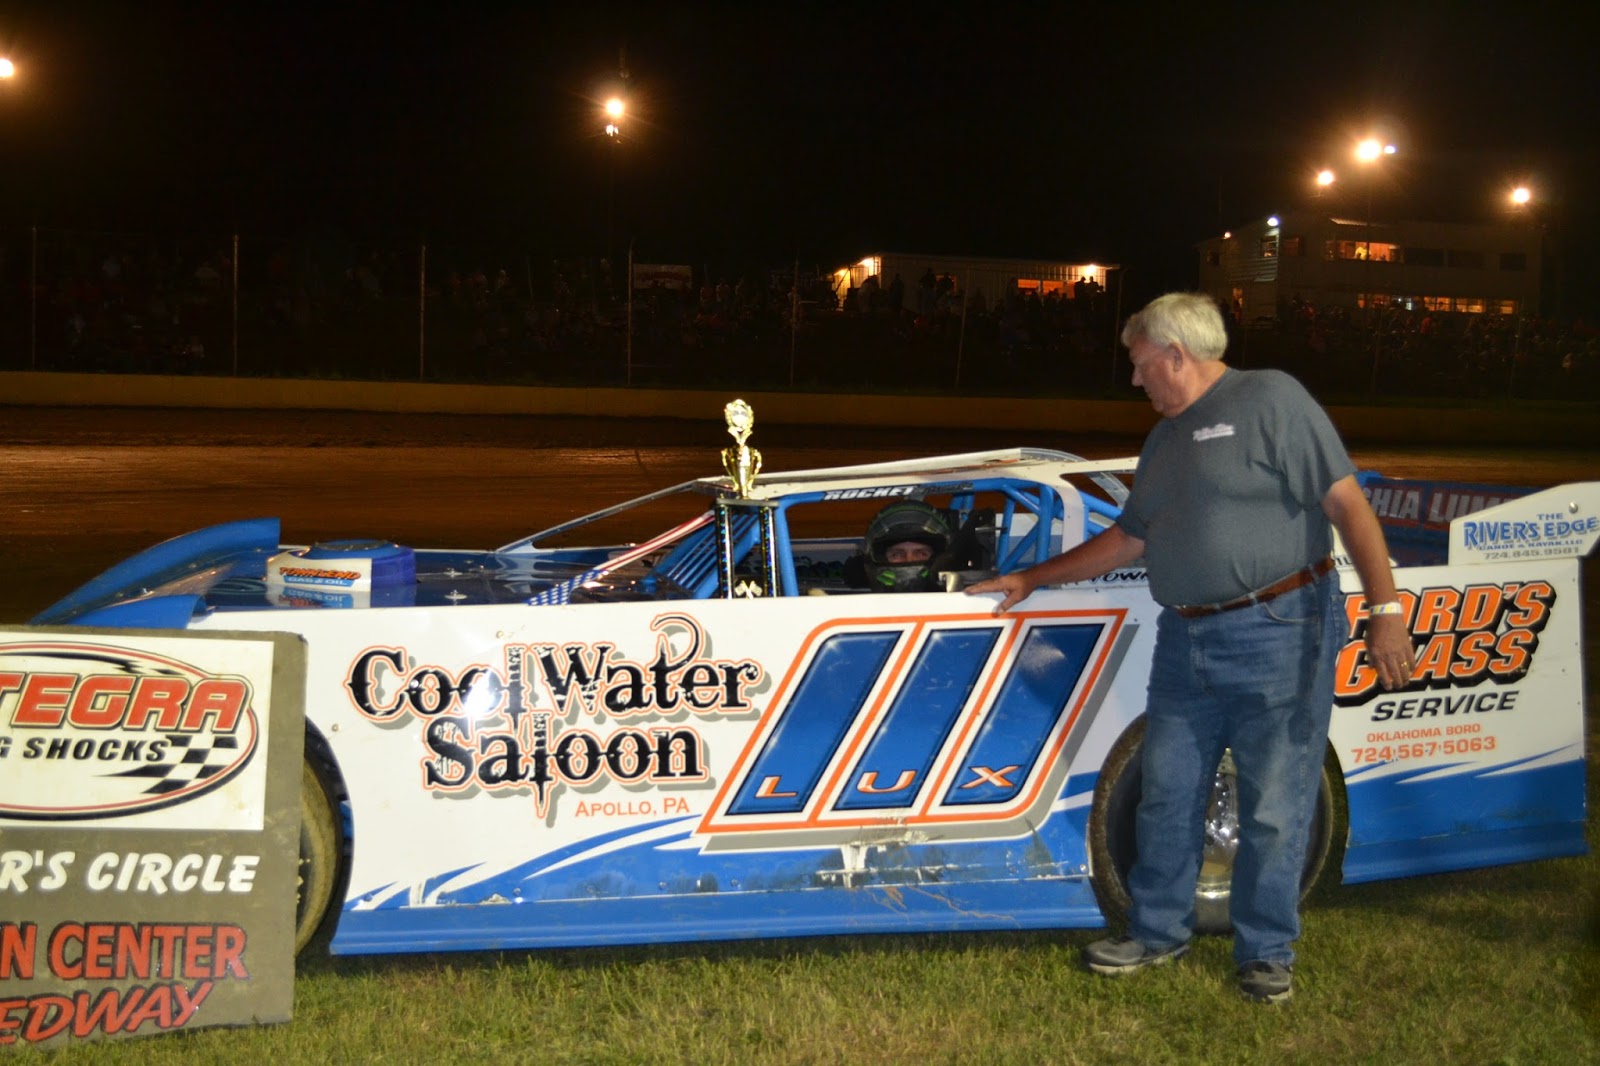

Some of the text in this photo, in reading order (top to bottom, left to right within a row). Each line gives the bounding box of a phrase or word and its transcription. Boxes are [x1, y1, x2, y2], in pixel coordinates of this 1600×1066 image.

[1464, 516, 1600, 547] RIVER'S EDGE
[1537, 512, 1563, 520] THE
[1344, 580, 1557, 640] FRD'S
[1333, 628, 1538, 702] GASS
[1371, 691, 1519, 722] SERVICE
[1367, 723, 1481, 743] OKLAHOMA BORO
[22, 736, 169, 762] SHOCKS
[421, 710, 708, 819] Saloon
[663, 797, 690, 813] PA
[87, 852, 260, 895] CIRCLE
[47, 920, 252, 981] CENTER
